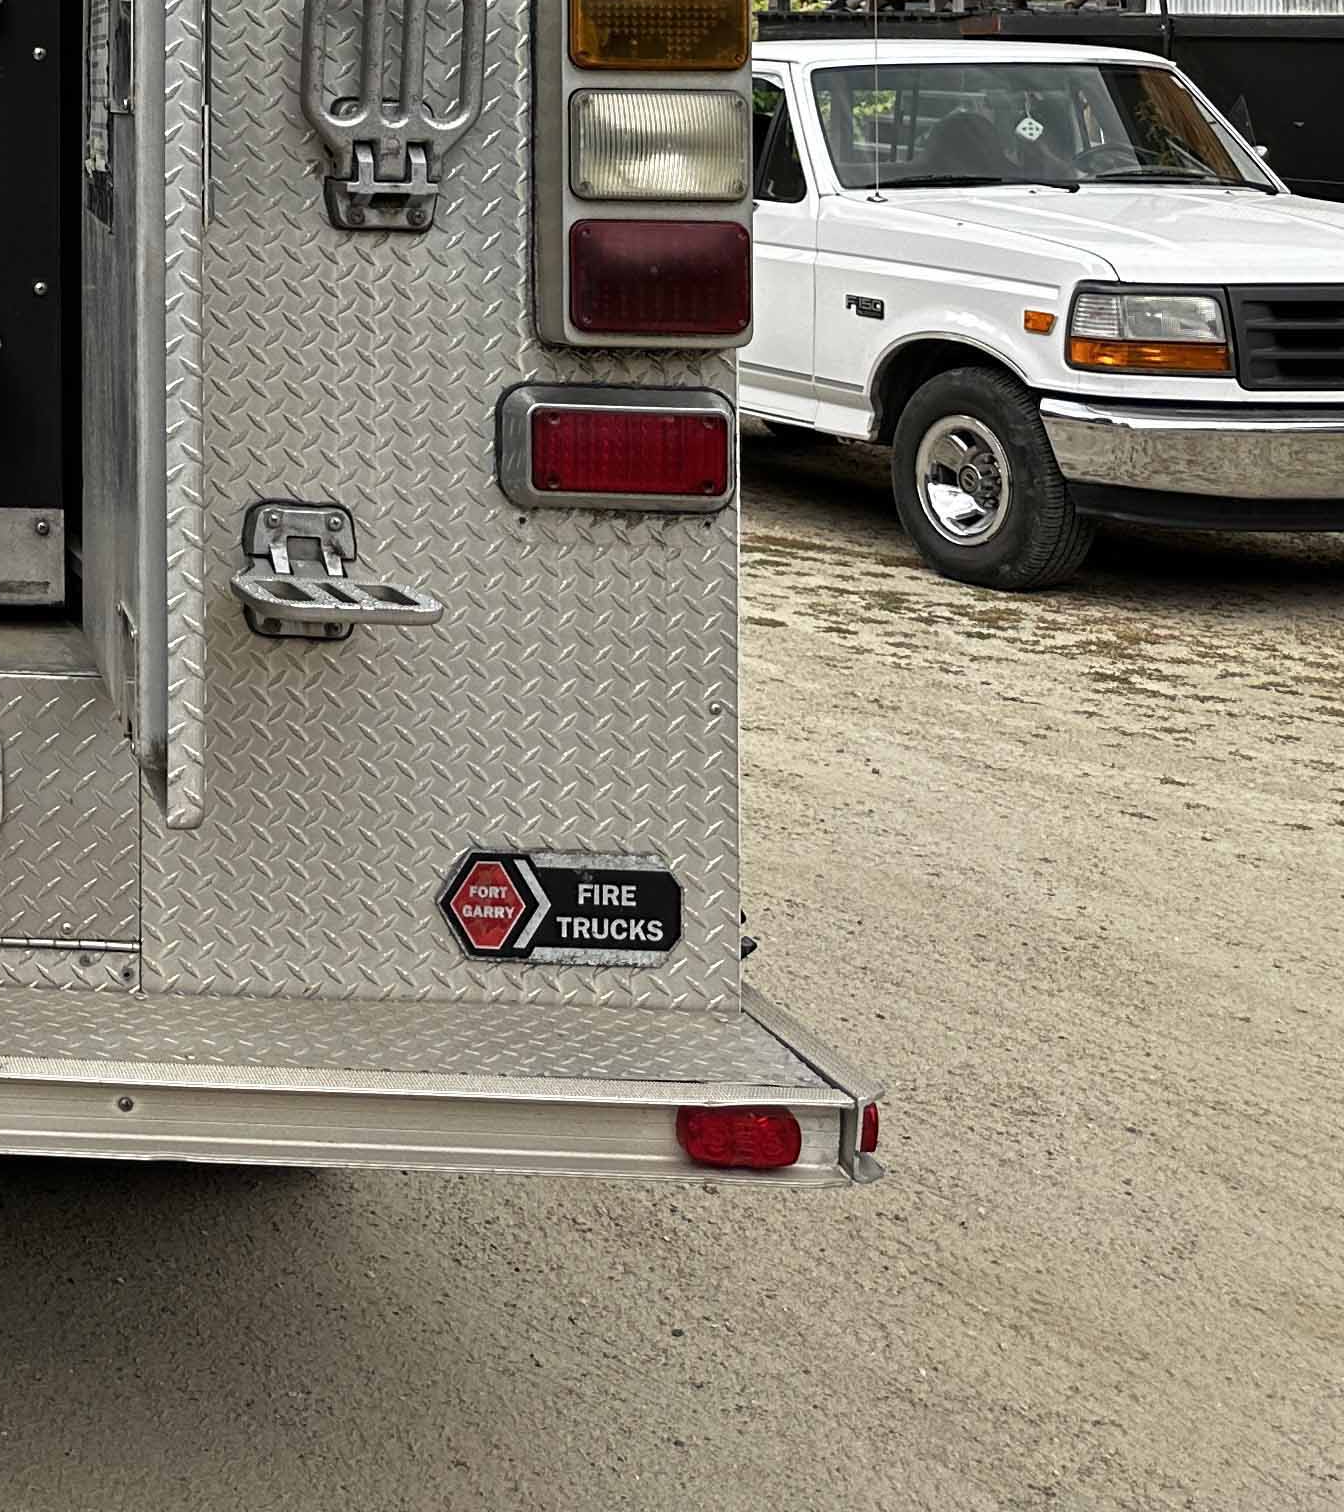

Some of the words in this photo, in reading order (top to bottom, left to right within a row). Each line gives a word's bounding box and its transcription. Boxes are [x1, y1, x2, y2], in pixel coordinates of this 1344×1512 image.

[469, 886, 508, 898] FORT
[578, 884, 638, 906] FIRE
[462, 905, 516, 919] GARRY
[556, 916, 664, 942] TRUCKS
